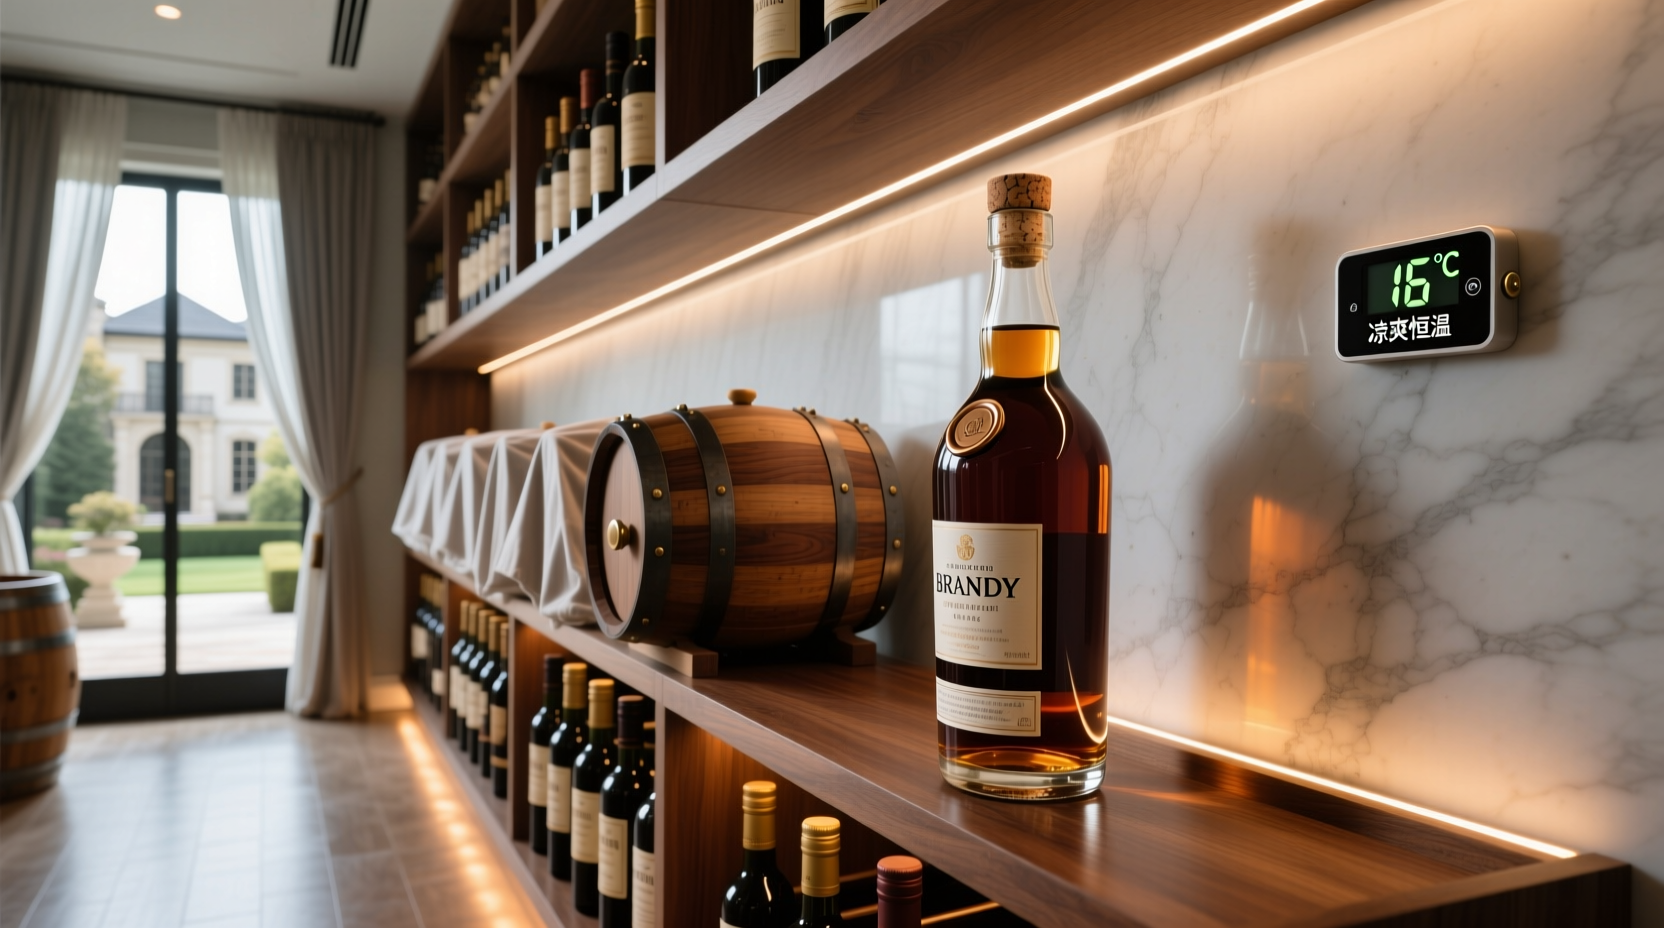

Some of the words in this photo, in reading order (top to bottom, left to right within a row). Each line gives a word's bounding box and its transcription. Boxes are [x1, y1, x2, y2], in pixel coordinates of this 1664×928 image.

[1368, 313, 1452, 344] 凉爽恒温
[936, 572, 1021, 599] BRANDY
